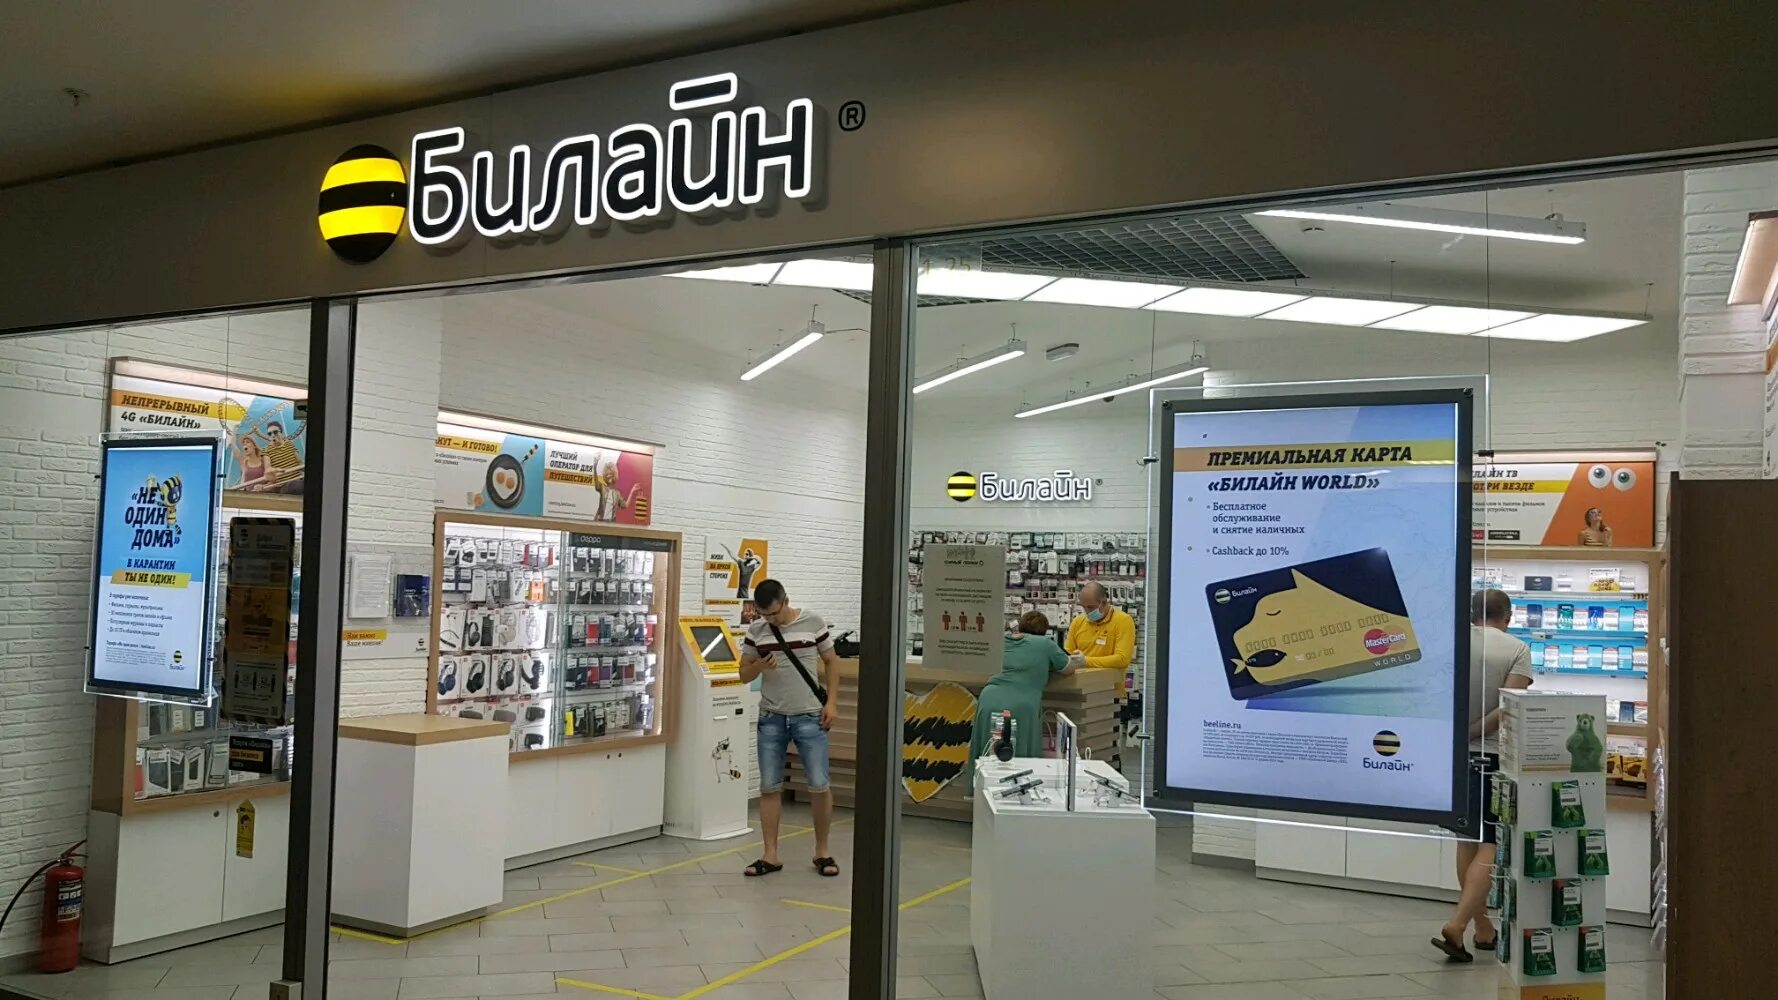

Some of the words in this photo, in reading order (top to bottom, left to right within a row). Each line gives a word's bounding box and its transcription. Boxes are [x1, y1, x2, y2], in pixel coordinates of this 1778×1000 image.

[409, 72, 813, 245] Билайн
[121, 394, 210, 415] НЕПРЕРЫВНЫЙ
[121, 411, 136, 422] 4G
[138, 414, 201, 429] «БИЛАЙН»
[469, 441, 498, 453] ГОТОВО!
[550, 450, 578, 461] ЛУЧШИЙ
[1207, 448, 1347, 468] ПРЕМИАЛЬНАЯ
[1350, 446, 1413, 463] КАРТА
[550, 460, 580, 471] ОПЕРАТОР
[549, 471, 593, 484] ПУТЕШЕСТВИЙ
[1506, 470, 1518, 478] ТВ
[980, 470, 1092, 501] Билайн
[1207, 472, 1299, 492] «БИЛАЙН
[1301, 474, 1380, 491] WORLD»
[1502, 482, 1535, 491] ВЕЗДЕ
[1213, 502, 1267, 511] Бесплатное
[124, 506, 168, 528] ОДИН
[1212, 514, 1281, 525] обслуживание
[1255, 526, 1305, 534] наличных
[130, 529, 181, 550] ДОМА»
[1212, 546, 1254, 556] Cashback
[1255, 549, 1267, 557] до
[1270, 546, 1289, 556] 10%
[133, 558, 176, 570] КАРАНТИН
[124, 571, 137, 582] ТЫ
[137, 573, 149, 584] НЕ
[149, 573, 177, 586] ОДИН!
[1231, 586, 1258, 598] Билайн
[1365, 632, 1406, 648] MasterCard
[1374, 653, 1412, 667] WORLD
[1203, 720, 1242, 729] beeline.ru
[1362, 757, 1411, 771] Билайн
